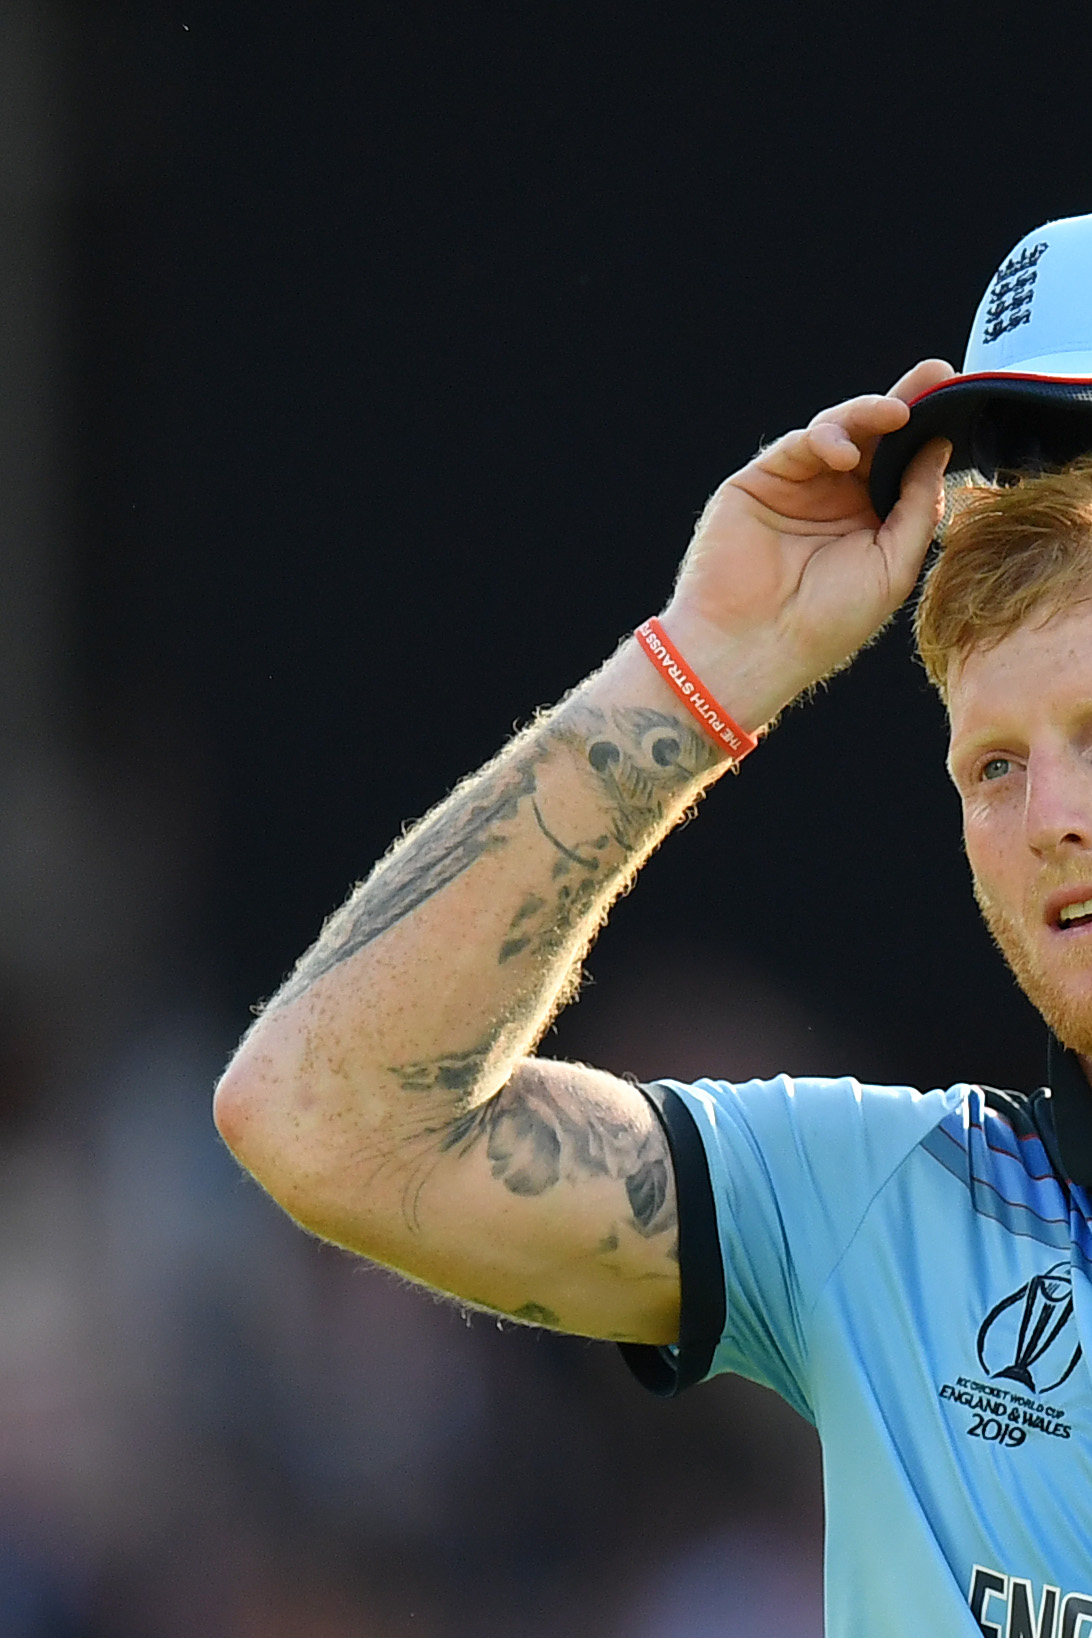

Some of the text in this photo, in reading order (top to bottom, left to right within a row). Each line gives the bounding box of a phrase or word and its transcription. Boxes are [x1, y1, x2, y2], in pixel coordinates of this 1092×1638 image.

[645, 633, 694, 695] STRAUSS
[690, 693, 725, 732] RUTH
[720, 728, 742, 751] THE
[939, 1384, 1072, 1439] ENGLAND & WALES
[1010, 1394, 1045, 1413] WORLD
[1045, 1406, 1065, 1419] CUP
[967, 1413, 1027, 1447] 2019
